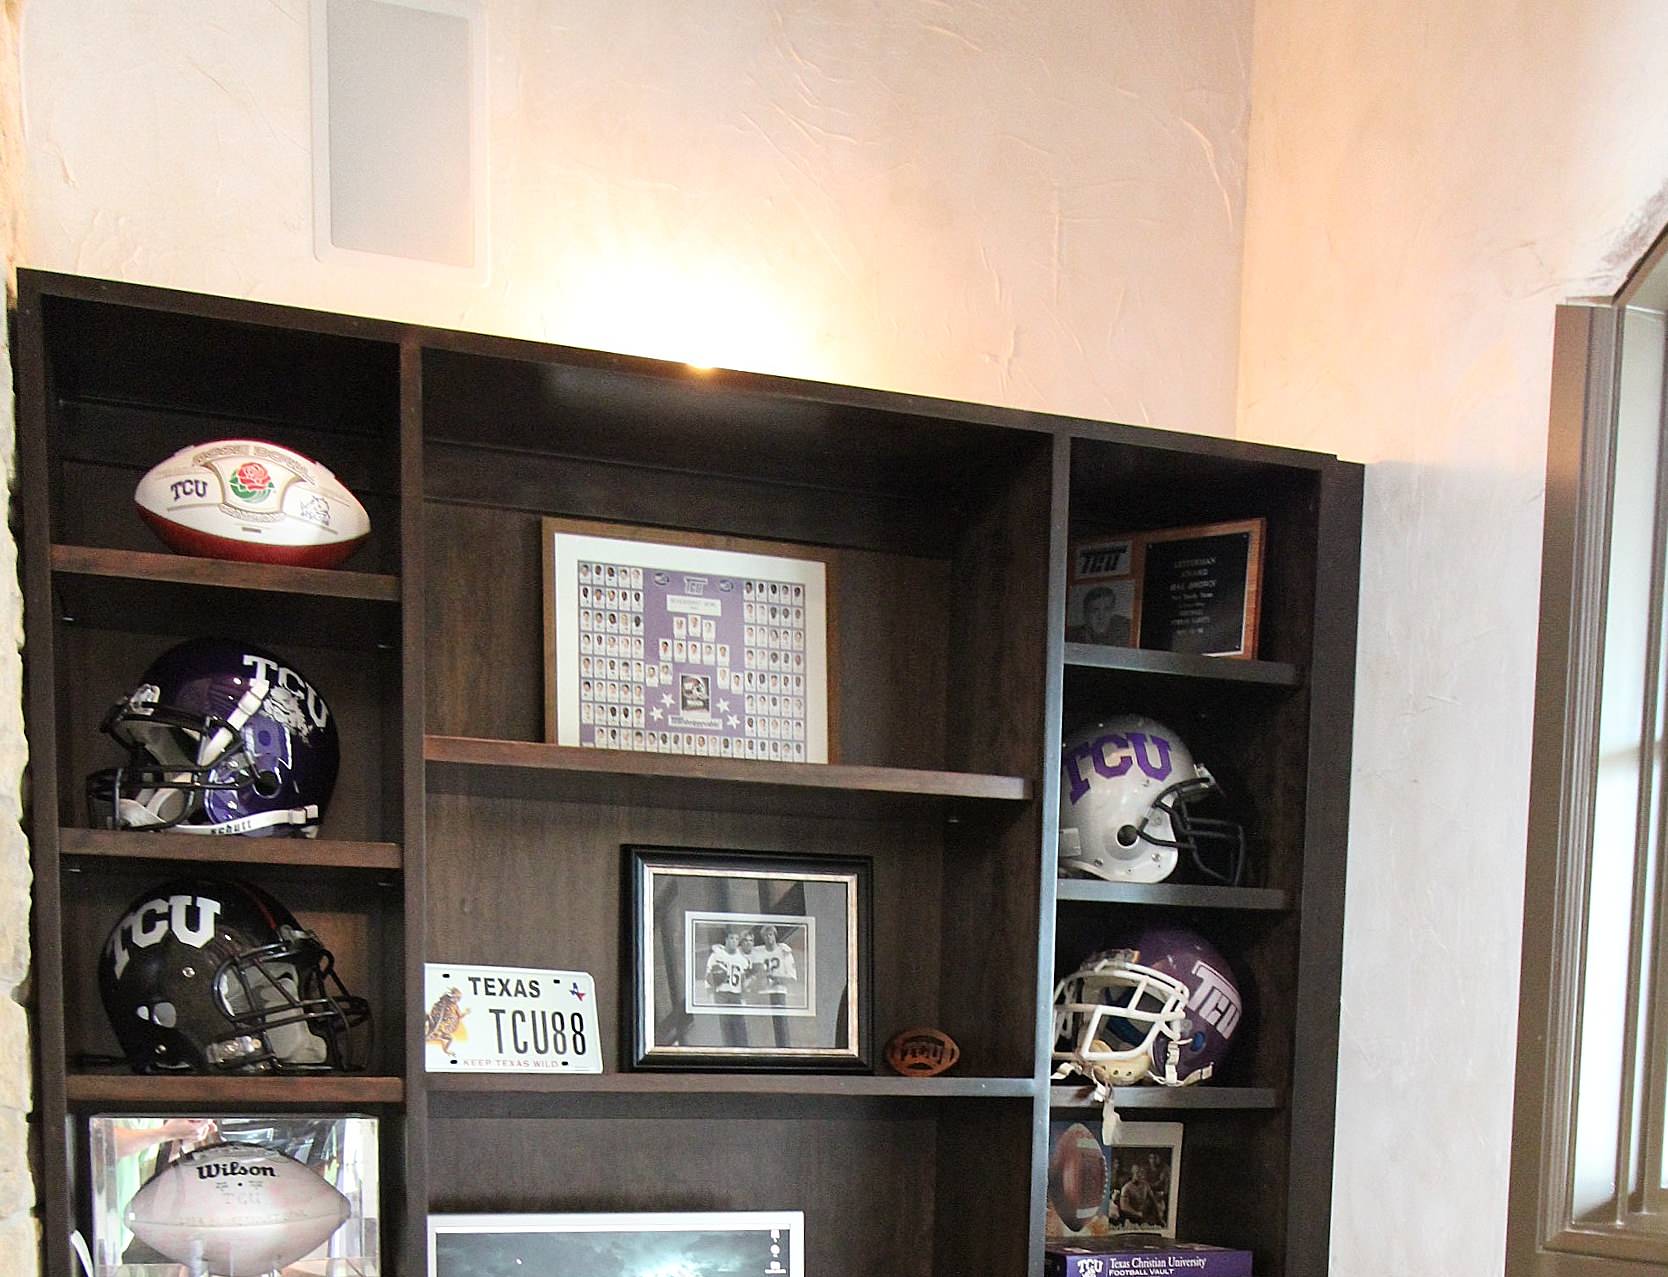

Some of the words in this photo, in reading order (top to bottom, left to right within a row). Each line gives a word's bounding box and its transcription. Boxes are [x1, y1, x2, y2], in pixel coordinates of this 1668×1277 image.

[170, 480, 208, 501] TCU
[242, 654, 329, 728] TCU
[1063, 732, 1172, 805] TCU
[110, 895, 221, 980] TCU
[468, 976, 541, 998] TEXAS
[1187, 960, 1242, 1039] TCU
[489, 1008, 587, 1055] TCU88
[464, 1059, 491, 1067] KEEP
[533, 1060, 559, 1068] WILD
[196, 1161, 277, 1179] Wilson
[1077, 1258, 1104, 1274] TCU
[1109, 1269, 1148, 1277] FOOTBALL
[1149, 1268, 1175, 1276] VAULT
[1110, 1257, 1131, 1269] Texas
[1131, 1256, 1167, 1269] Christian
[1168, 1256, 1206, 1269] University
